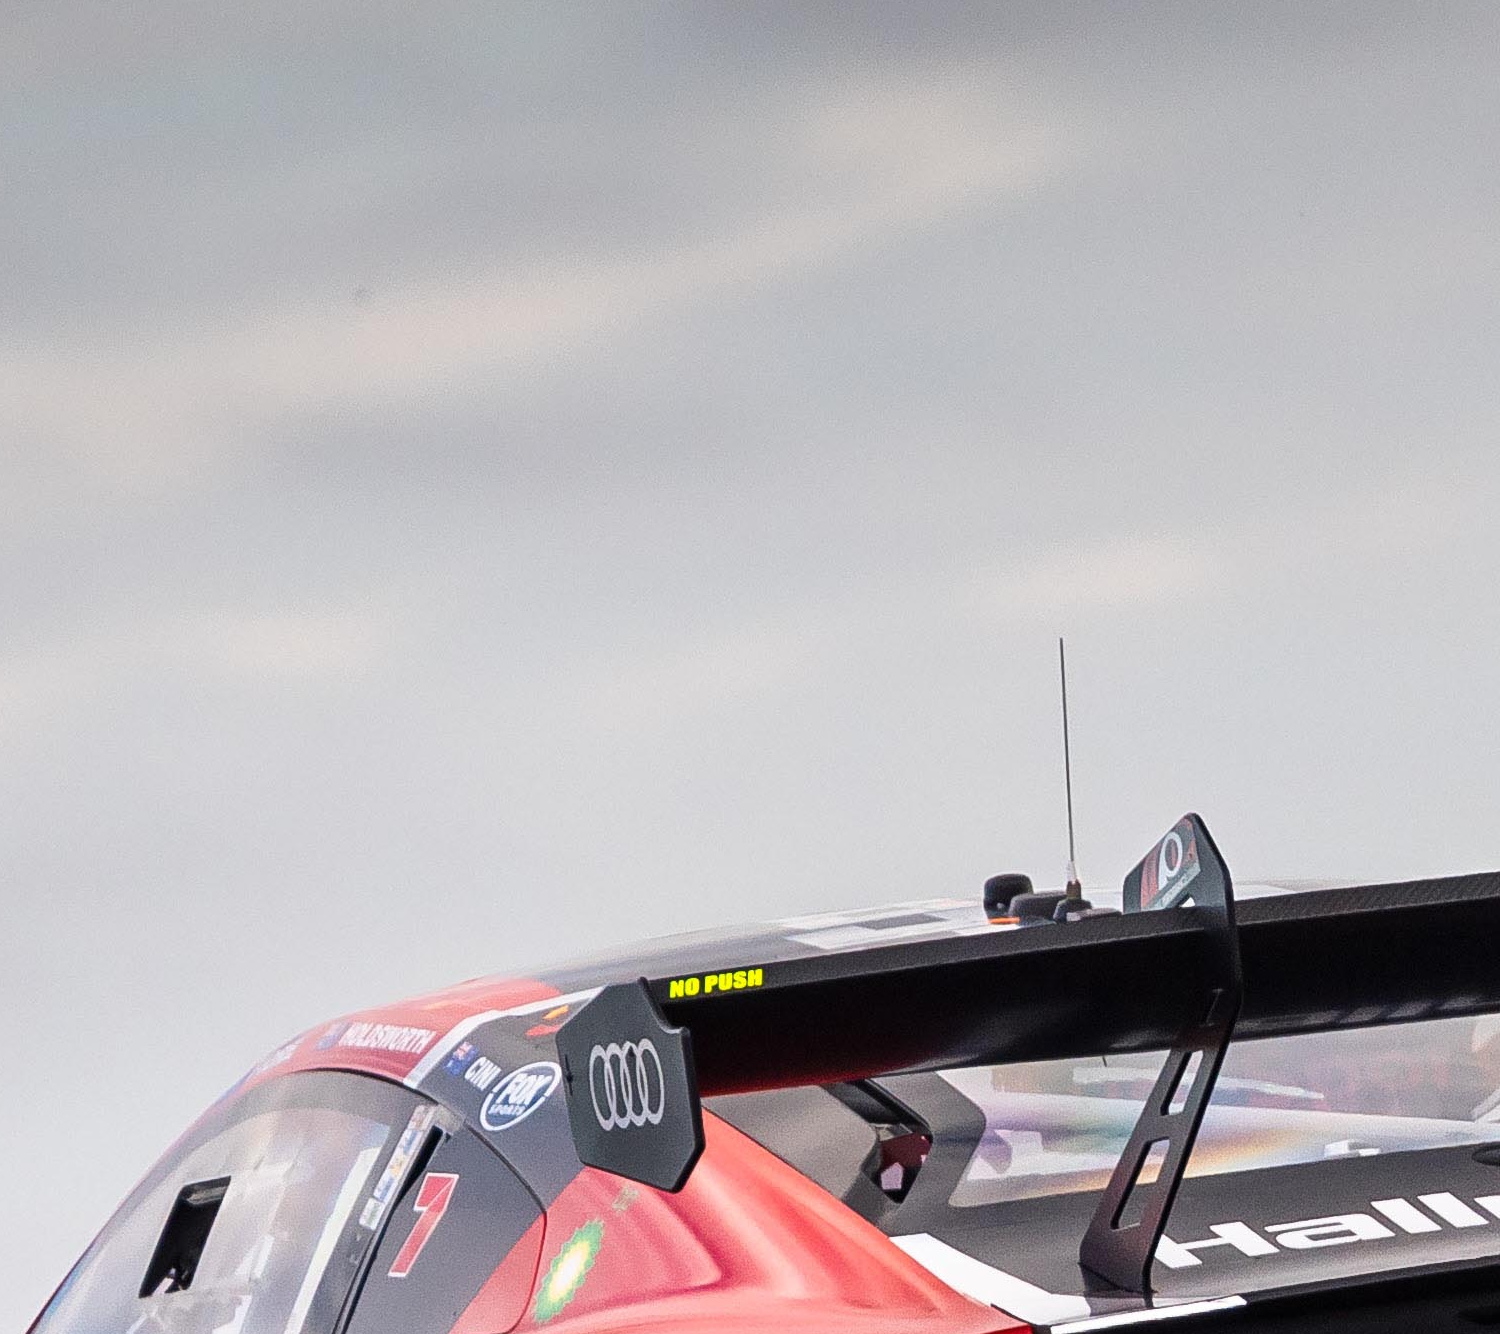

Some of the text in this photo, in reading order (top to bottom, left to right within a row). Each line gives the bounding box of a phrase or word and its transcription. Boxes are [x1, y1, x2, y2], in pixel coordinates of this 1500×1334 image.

[669, 969, 763, 999] NO PUSH
[338, 1021, 437, 1055] HOLDSWORTH
[494, 1072, 553, 1105] FOX
[387, 1172, 460, 1278] 1
